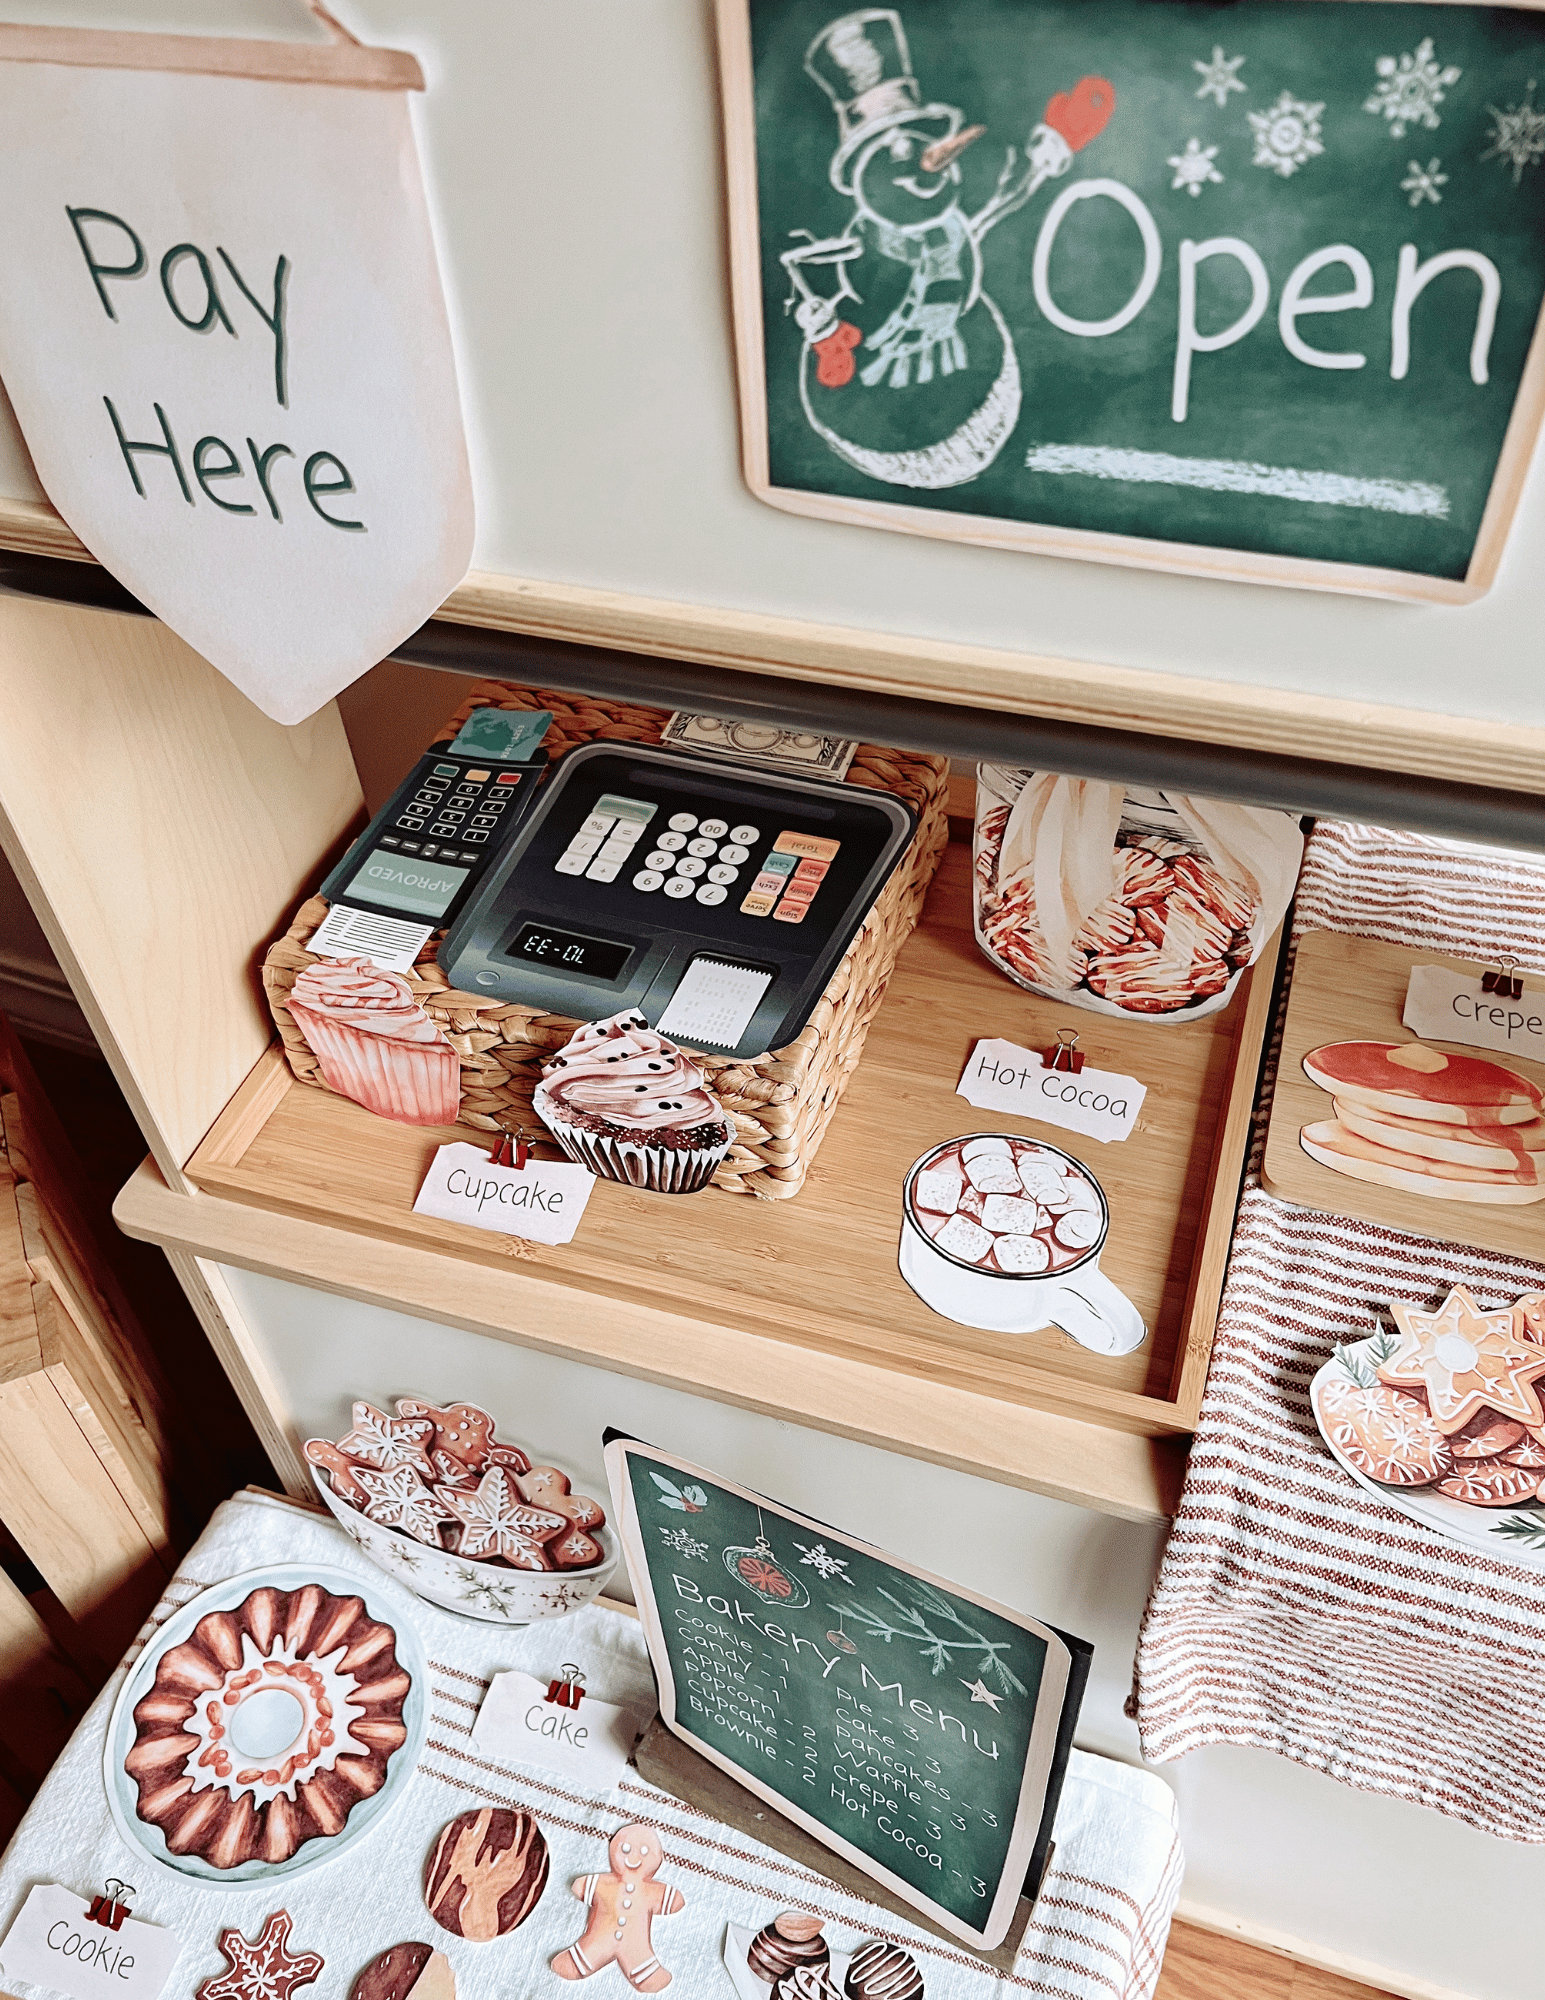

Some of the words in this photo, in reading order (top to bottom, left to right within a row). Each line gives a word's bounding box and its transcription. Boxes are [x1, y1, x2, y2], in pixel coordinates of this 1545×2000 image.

[66, 205, 291, 409] Pay
[1032, 177, 1501, 422] Open
[103, 395, 367, 531] Here
[667, 838, 676, 846] 3
[697, 844, 706, 852] 2
[704, 825, 722, 834] 00
[729, 851, 736, 859] 1
[740, 832, 749, 840] 0
[791, 842, 819, 854] Total
[368, 866, 455, 893] APROVED
[643, 877, 652, 885] 9
[655, 857, 665, 865] 6
[685, 863, 693, 872] 5
[718, 870, 727, 878] 4
[674, 884, 684, 892] 8
[704, 891, 715, 899] 7
[746, 903, 766, 912] Serve
[1453, 994, 1543, 1039] Crepe
[978, 1056, 1031, 1089] Hot
[1041, 1076, 1128, 1118] Cocoa
[447, 1169, 564, 1213] Cupcake
[672, 1573, 840, 1678] Bakery
[860, 1663, 998, 1760] Menu
[675, 1609, 753, 1652] Cookie
[781, 1658, 789, 1671] 1
[679, 1627, 752, 1673] Candy
[780, 1676, 787, 1689] 1
[683, 1647, 746, 1684] Apple
[772, 1690, 780, 1703] 1
[685, 1661, 774, 1718] Popcorn
[803, 1725, 816, 1742] 2
[525, 1705, 588, 1748] Cake
[688, 1680, 777, 1739] Cupcake
[805, 1746, 817, 1764] 2
[690, 1695, 776, 1759] Brownie
[803, 1766, 816, 1785] 2
[836, 1687, 872, 1716] Pie
[903, 1724, 919, 1740] 3
[836, 1708, 895, 1749] Cake
[925, 1756, 941, 1774] 3
[833, 1765, 898, 1814] Crepe
[925, 1821, 941, 1840] 3
[834, 1742, 921, 1805] Waffle
[950, 1813, 966, 1831] 3
[836, 1725, 950, 1800] Pancakes
[981, 1809, 998, 1827] 3
[831, 1783, 870, 1818] Hot
[877, 1817, 942, 1869] Cocoa
[970, 1876, 986, 1898] 3
[47, 1921, 134, 1979] Cookie
